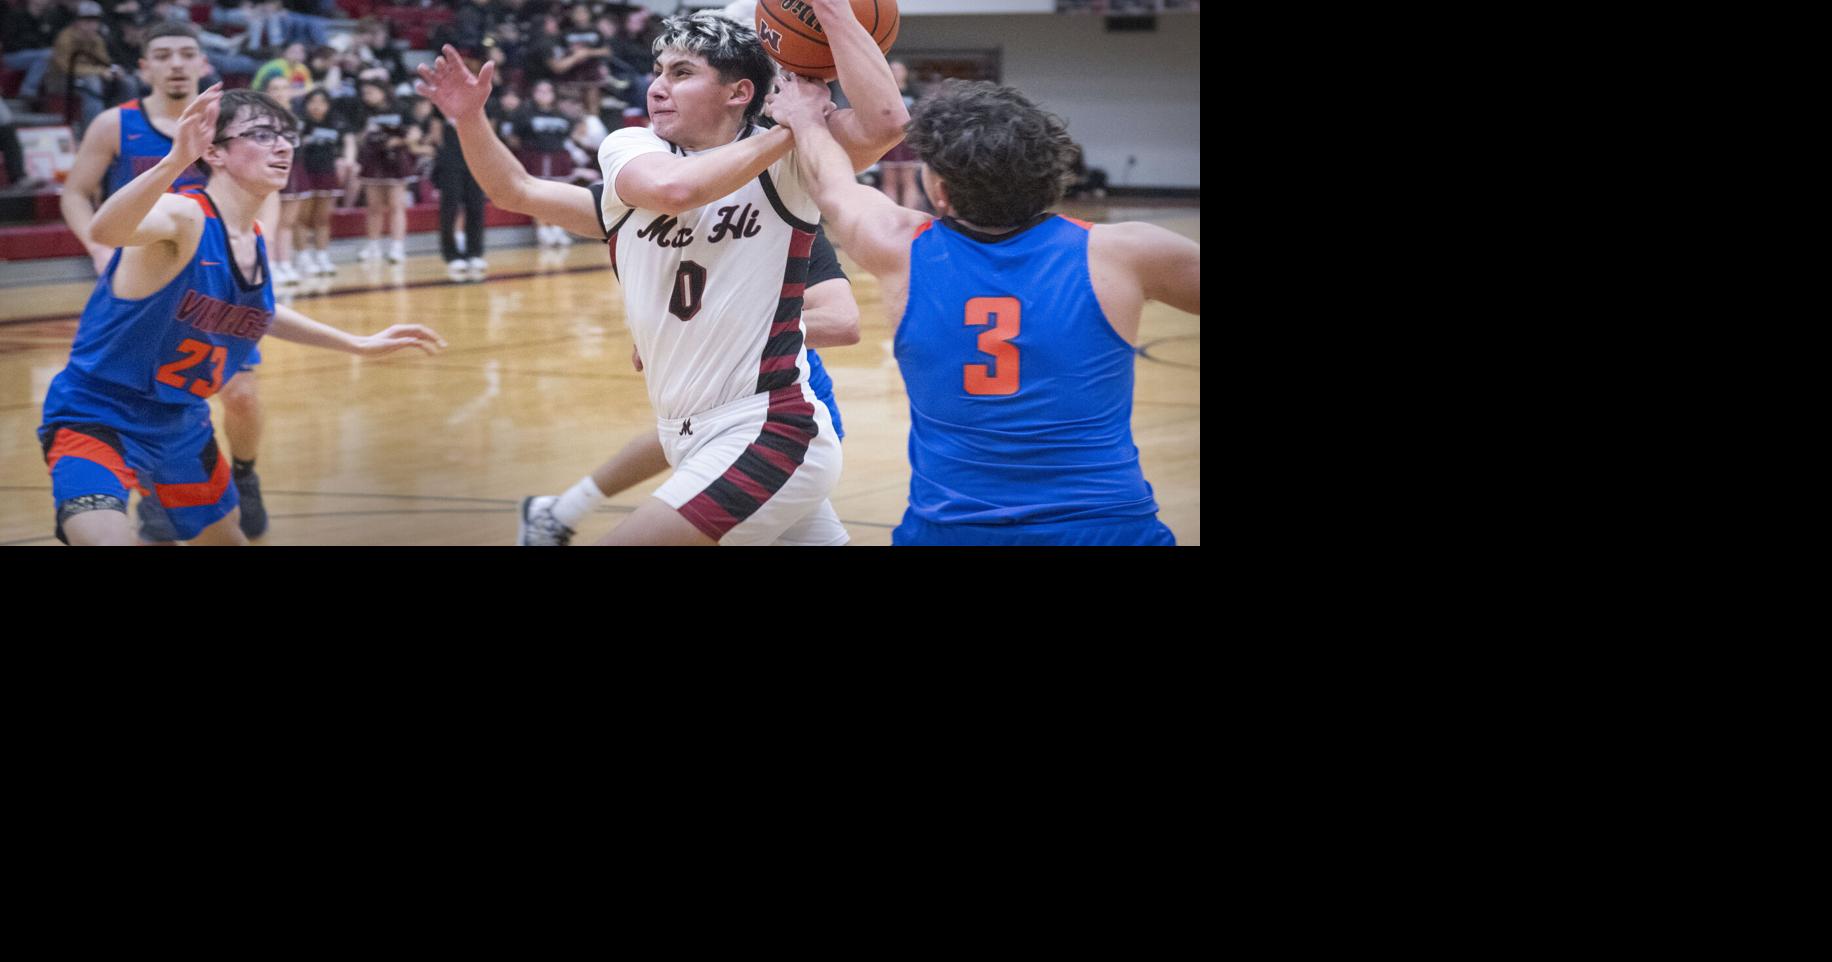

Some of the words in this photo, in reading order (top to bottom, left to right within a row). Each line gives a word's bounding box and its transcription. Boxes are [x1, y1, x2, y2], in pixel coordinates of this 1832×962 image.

[707, 203, 762, 243] Hi
[669, 260, 707, 321] 0
[156, 338, 228, 399] 23
[963, 296, 1021, 395] 3
